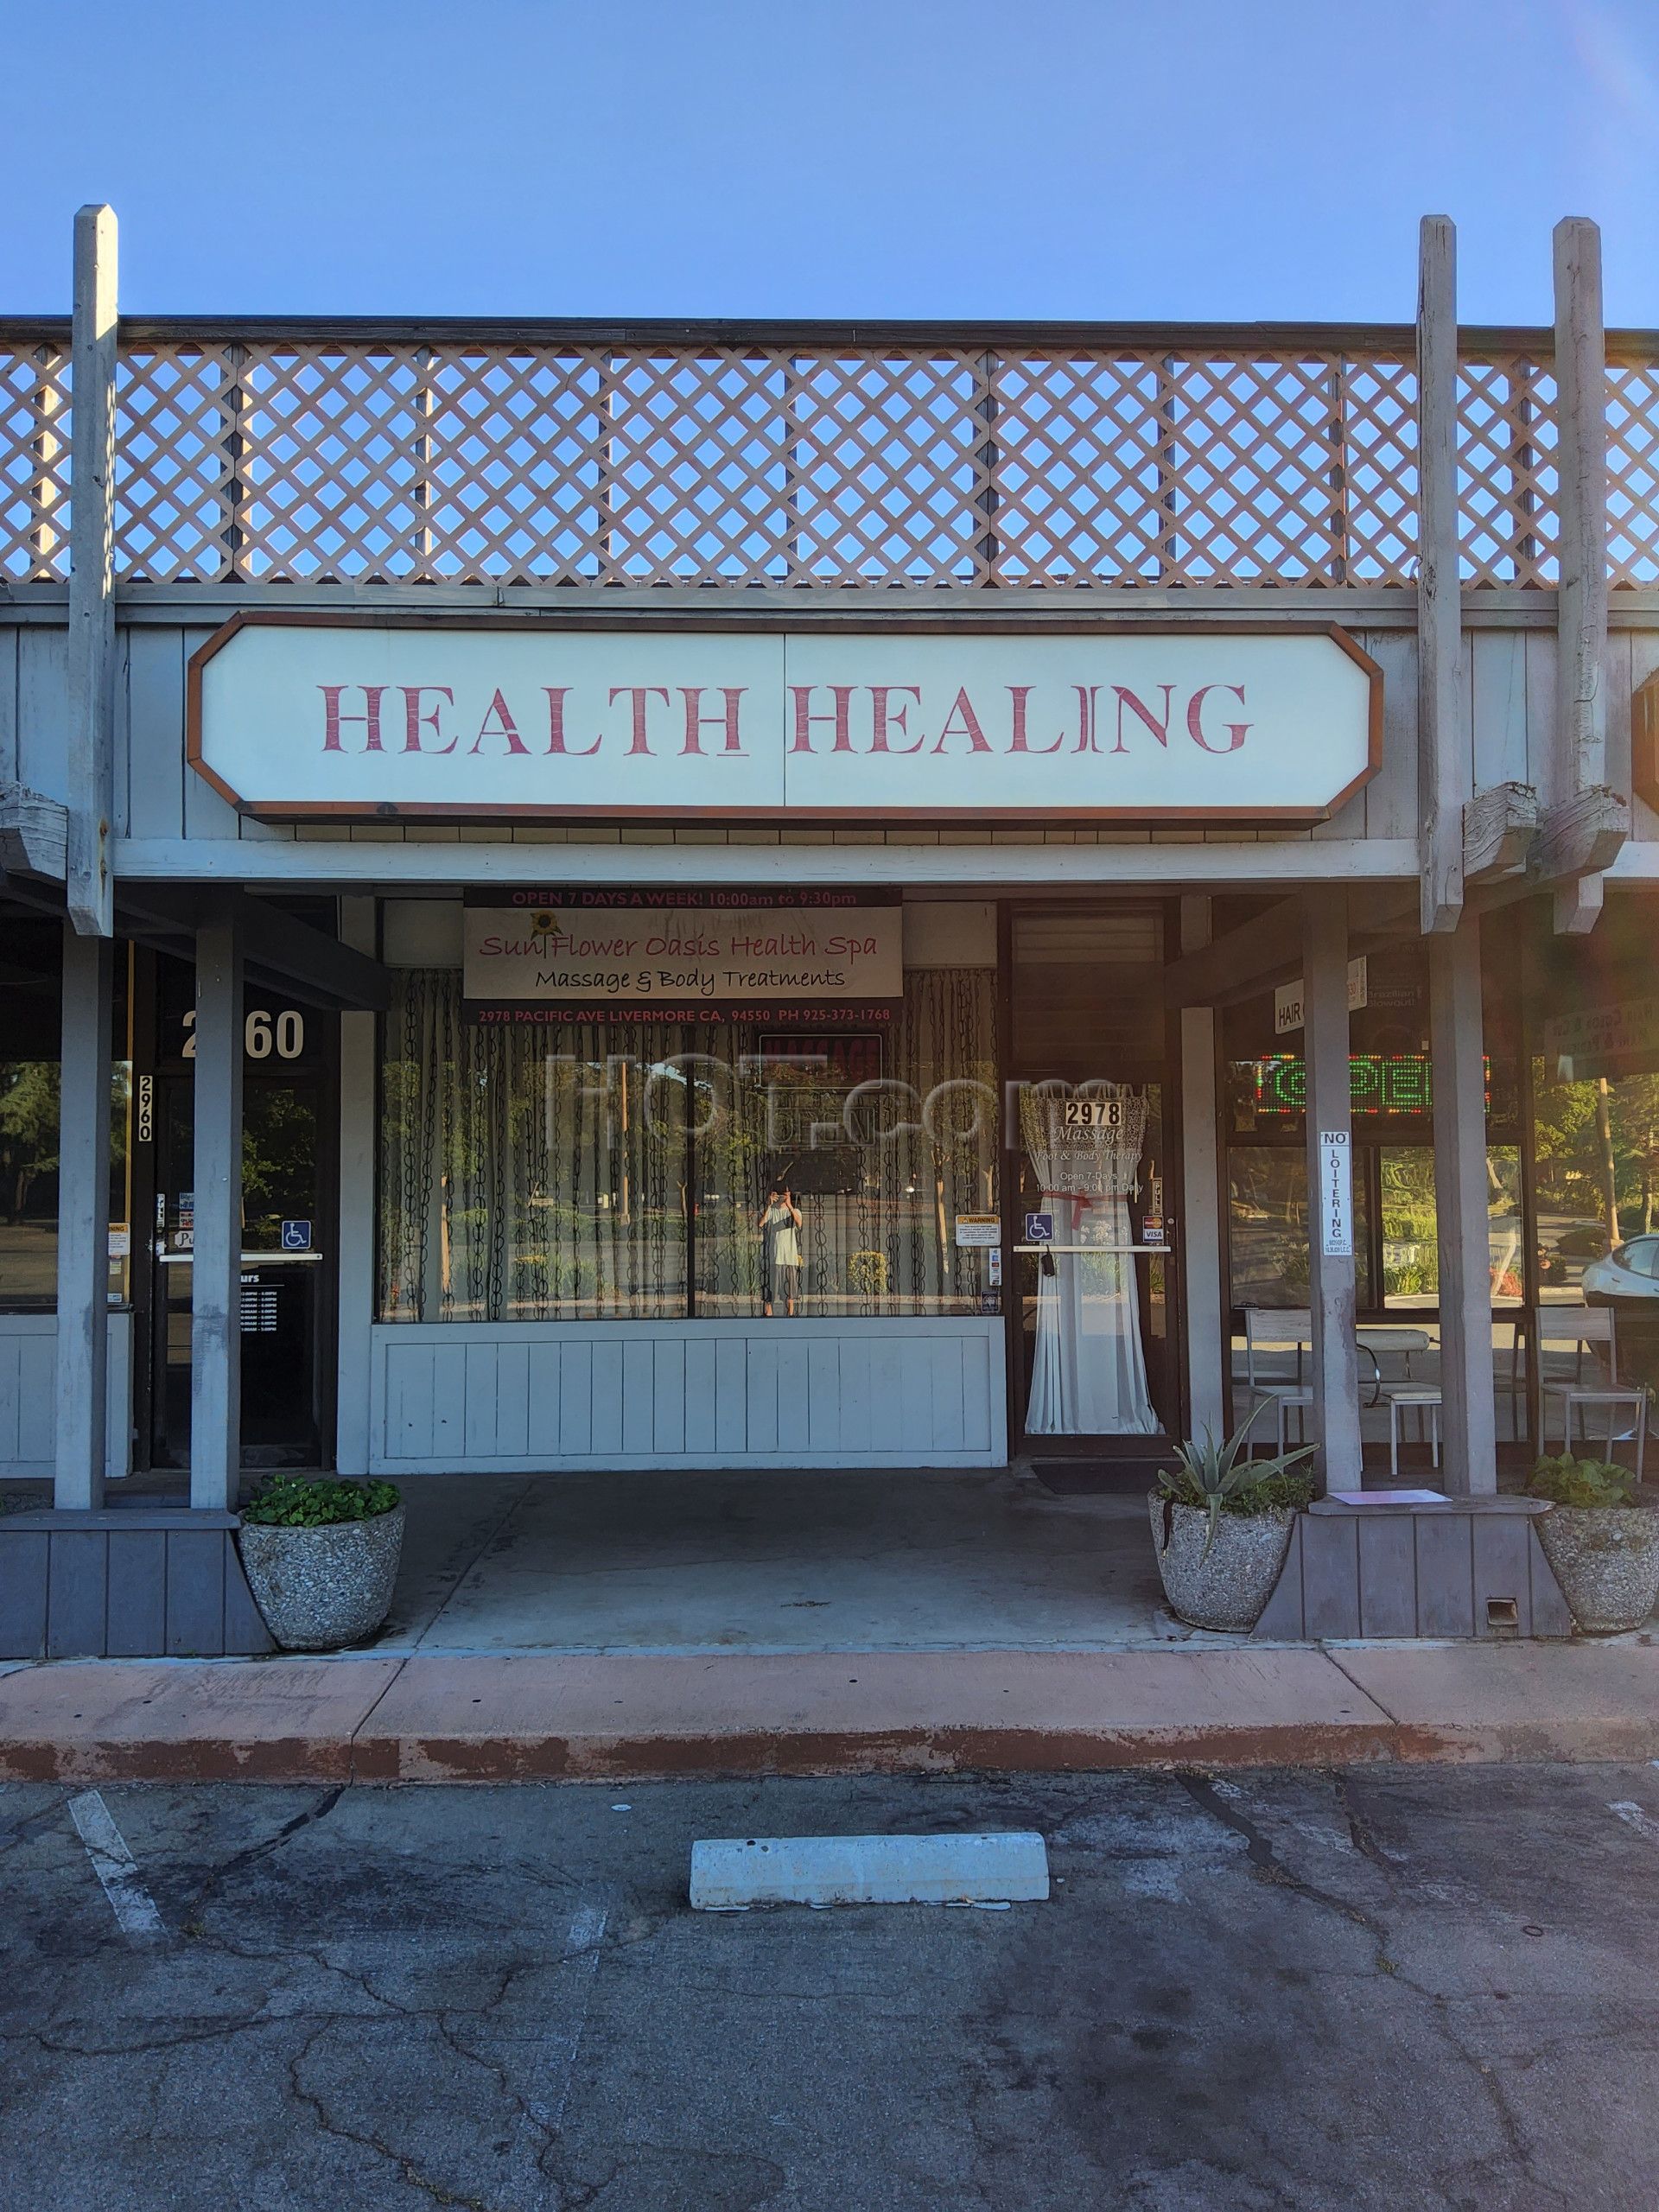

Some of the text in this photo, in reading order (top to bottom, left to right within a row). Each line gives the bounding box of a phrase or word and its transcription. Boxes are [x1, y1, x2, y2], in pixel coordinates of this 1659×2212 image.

[316, 683, 1255, 757] HEALTH HEALING
[512, 891, 856, 908] OPEN 7 DAYS A WEEK! 10:00am to 9:30pm
[645, 936, 720, 957] Oasis
[730, 935, 816, 957] Health
[824, 936, 877, 965] Spa
[535, 969, 845, 997] Massage & Body Treatments
[479, 1009, 891, 1023] 2978 PACIFIC AVE LIVERMORE CA, 94550 PH 925-373-1768
[1279, 1002, 1301, 1027] HAIR
[139, 1077, 151, 1141] 2960
[1067, 1103, 1120, 1124] 2978
[1053, 1126, 1124, 1145] Massage
[1325, 1133, 1346, 1145] NO
[1036, 1150, 1143, 1163] Foot & Body Therapy
[1060, 1172, 1118, 1182] Open 7-Days
[1037, 1184, 1059, 1192] 10:00
[1105, 1185, 1120, 1194] pm
[1331, 1149, 1342, 1238] LOITERING
